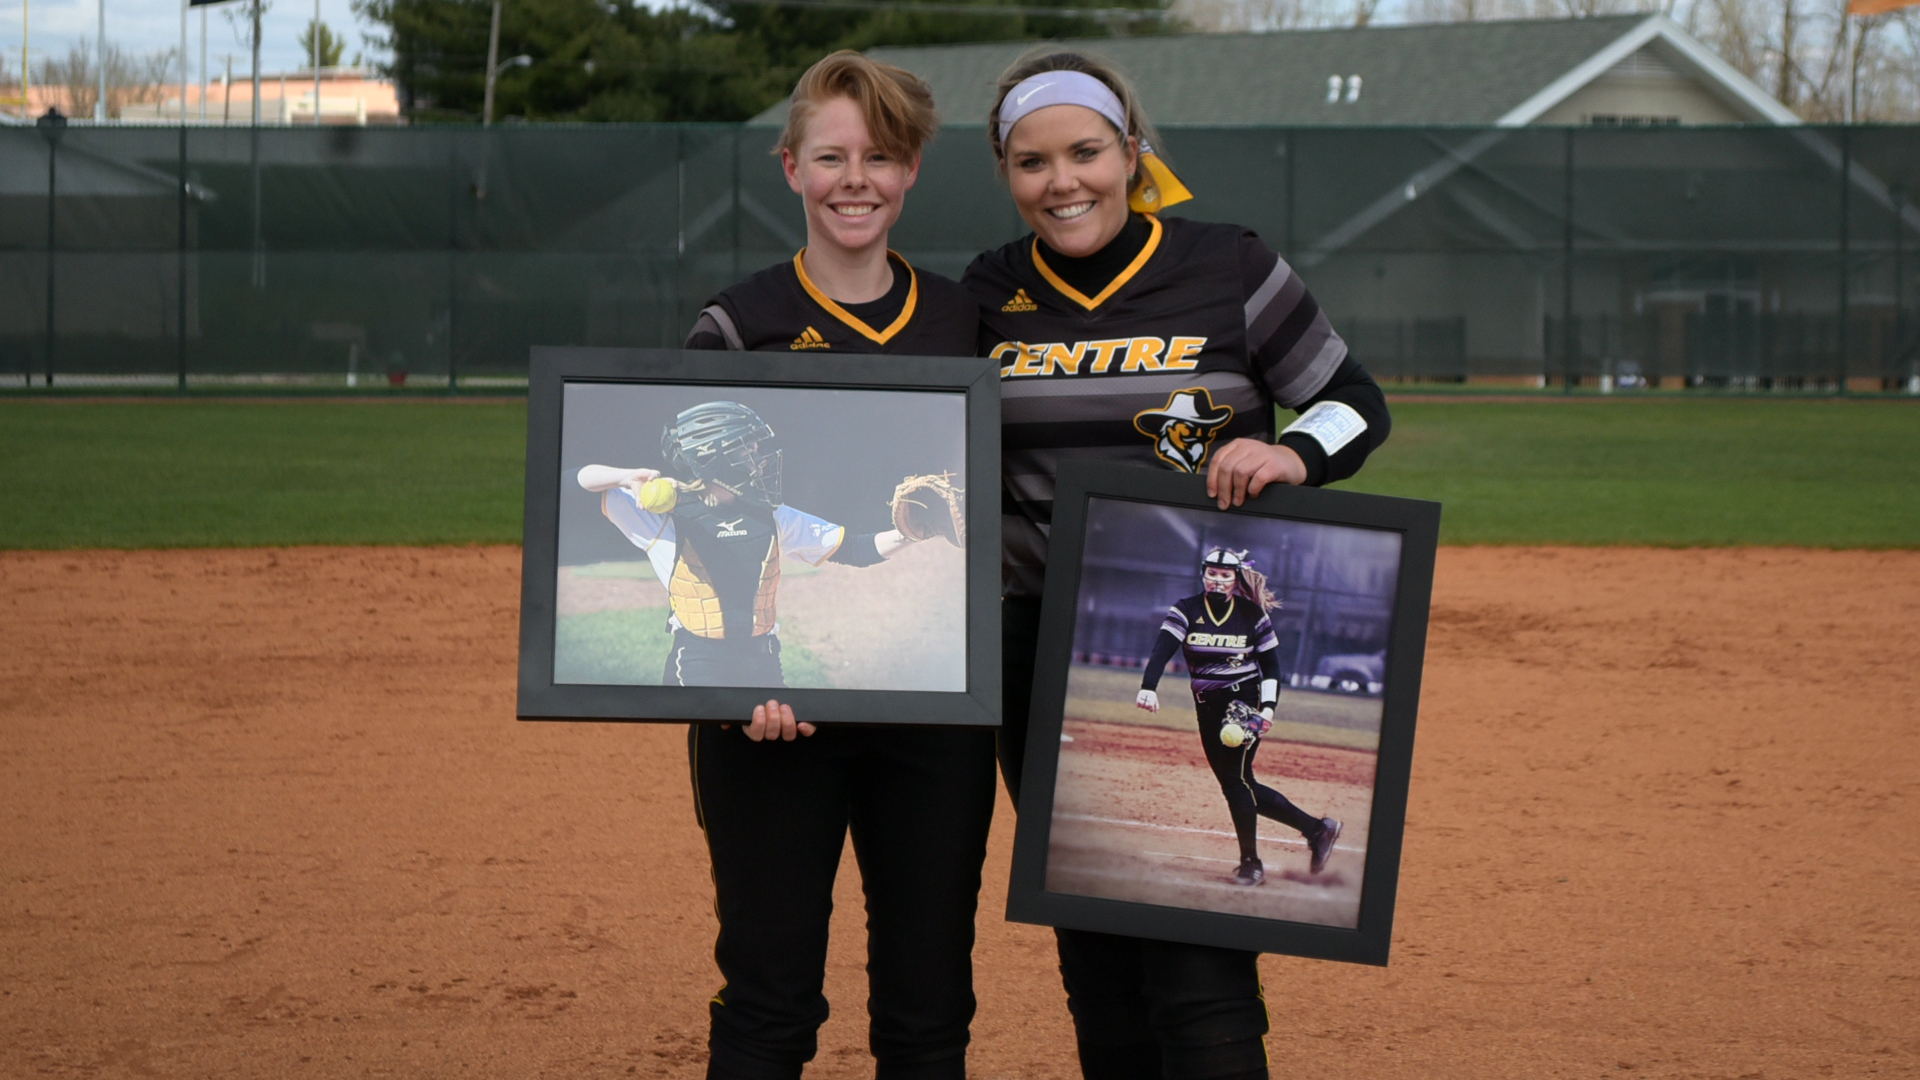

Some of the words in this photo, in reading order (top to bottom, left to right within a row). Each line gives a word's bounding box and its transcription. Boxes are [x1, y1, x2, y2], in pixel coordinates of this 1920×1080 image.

[1001, 304, 1038, 312] adidas
[989, 336, 1208, 378] CENTRE
[1186, 632, 1248, 648] CENTRE
